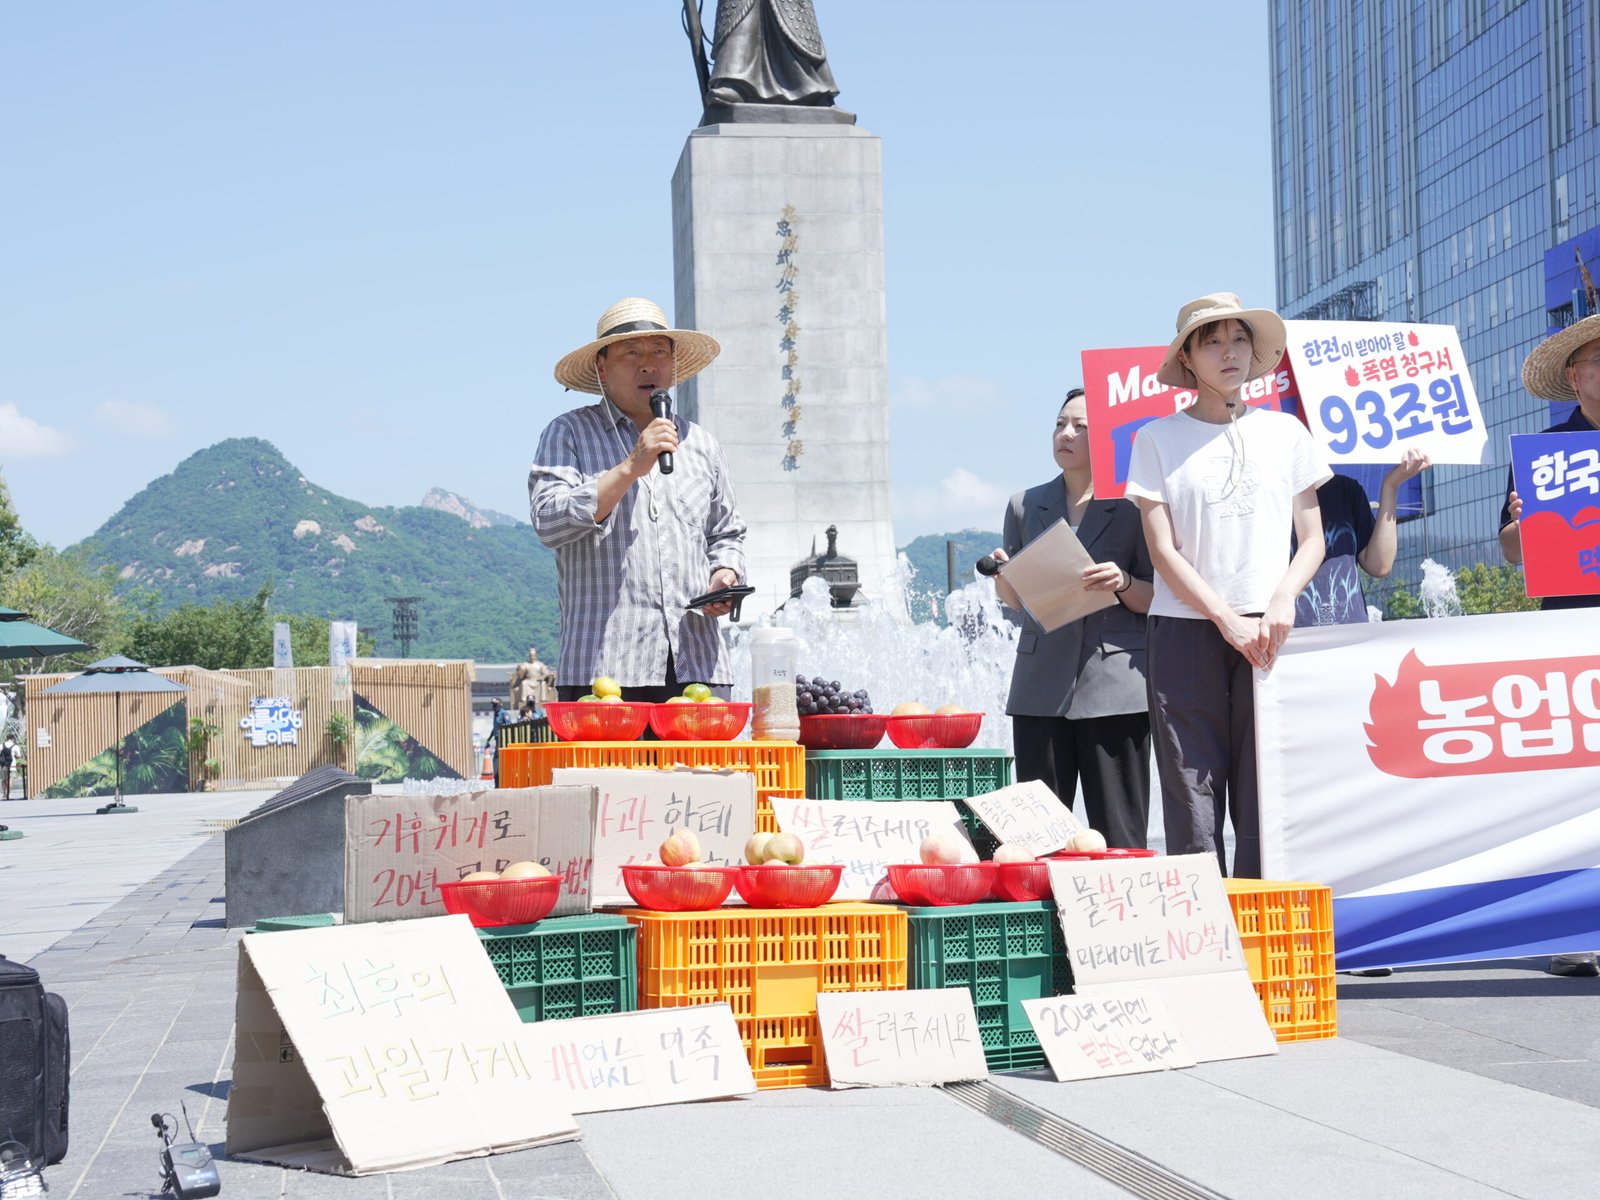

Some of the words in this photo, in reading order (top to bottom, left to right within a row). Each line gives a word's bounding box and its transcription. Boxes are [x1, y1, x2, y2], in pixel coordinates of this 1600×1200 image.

[1302, 335, 1355, 366] 한전이
[1355, 335, 1392, 357] 받아야
[1392, 331, 1406, 351] 할
[1362, 355, 1399, 383] 폭염
[1400, 347, 1453, 378] 청구서
[1319, 374, 1473, 455] 93조원
[370, 810, 526, 854] 기후위기로
[304, 957, 457, 1020] 최후의
[832, 1007, 971, 1067] 쌀려주세요
[326, 1037, 533, 1101] 과일가게
